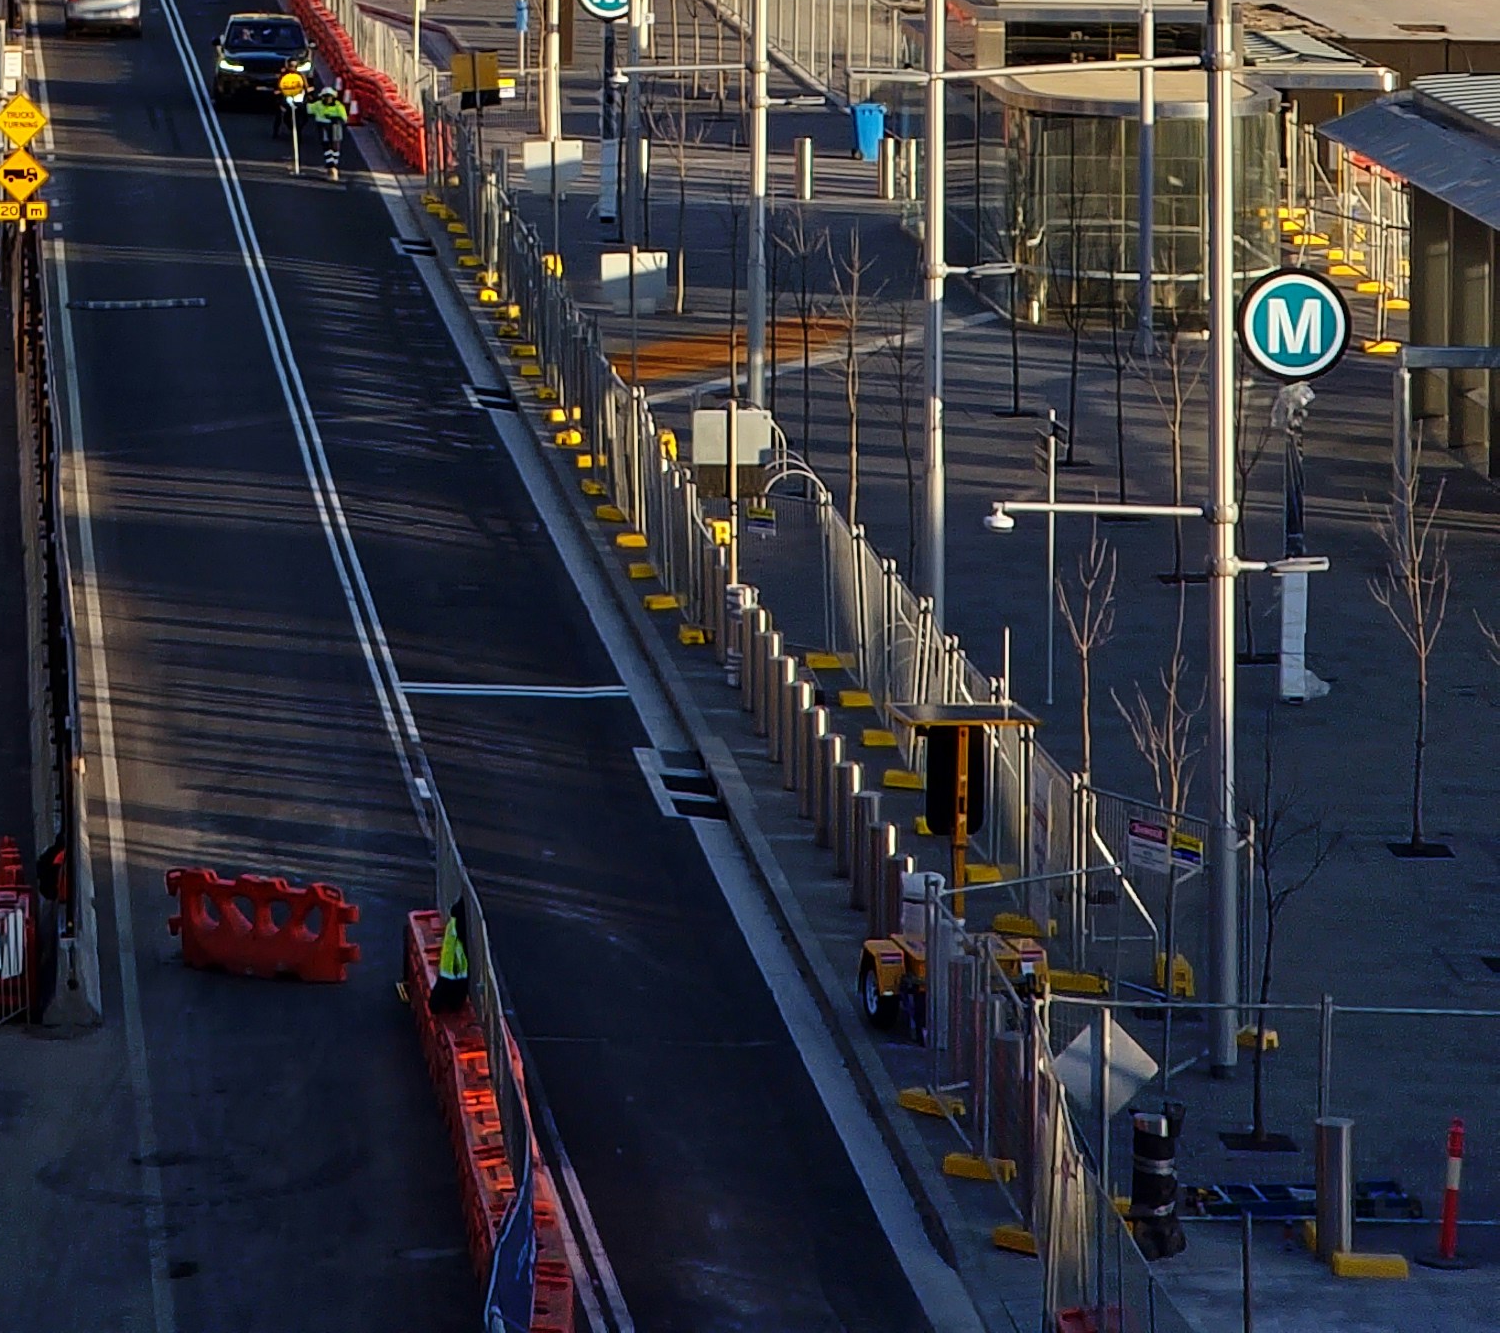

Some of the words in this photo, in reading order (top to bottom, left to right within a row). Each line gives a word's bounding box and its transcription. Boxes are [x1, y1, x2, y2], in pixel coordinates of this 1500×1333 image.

[6, 111, 35, 119] TRUCKS
[3, 120, 38, 129] TURNING
[0, 205, 18, 216] 20
[30, 207, 42, 216] m
[1267, 297, 1321, 354] M
